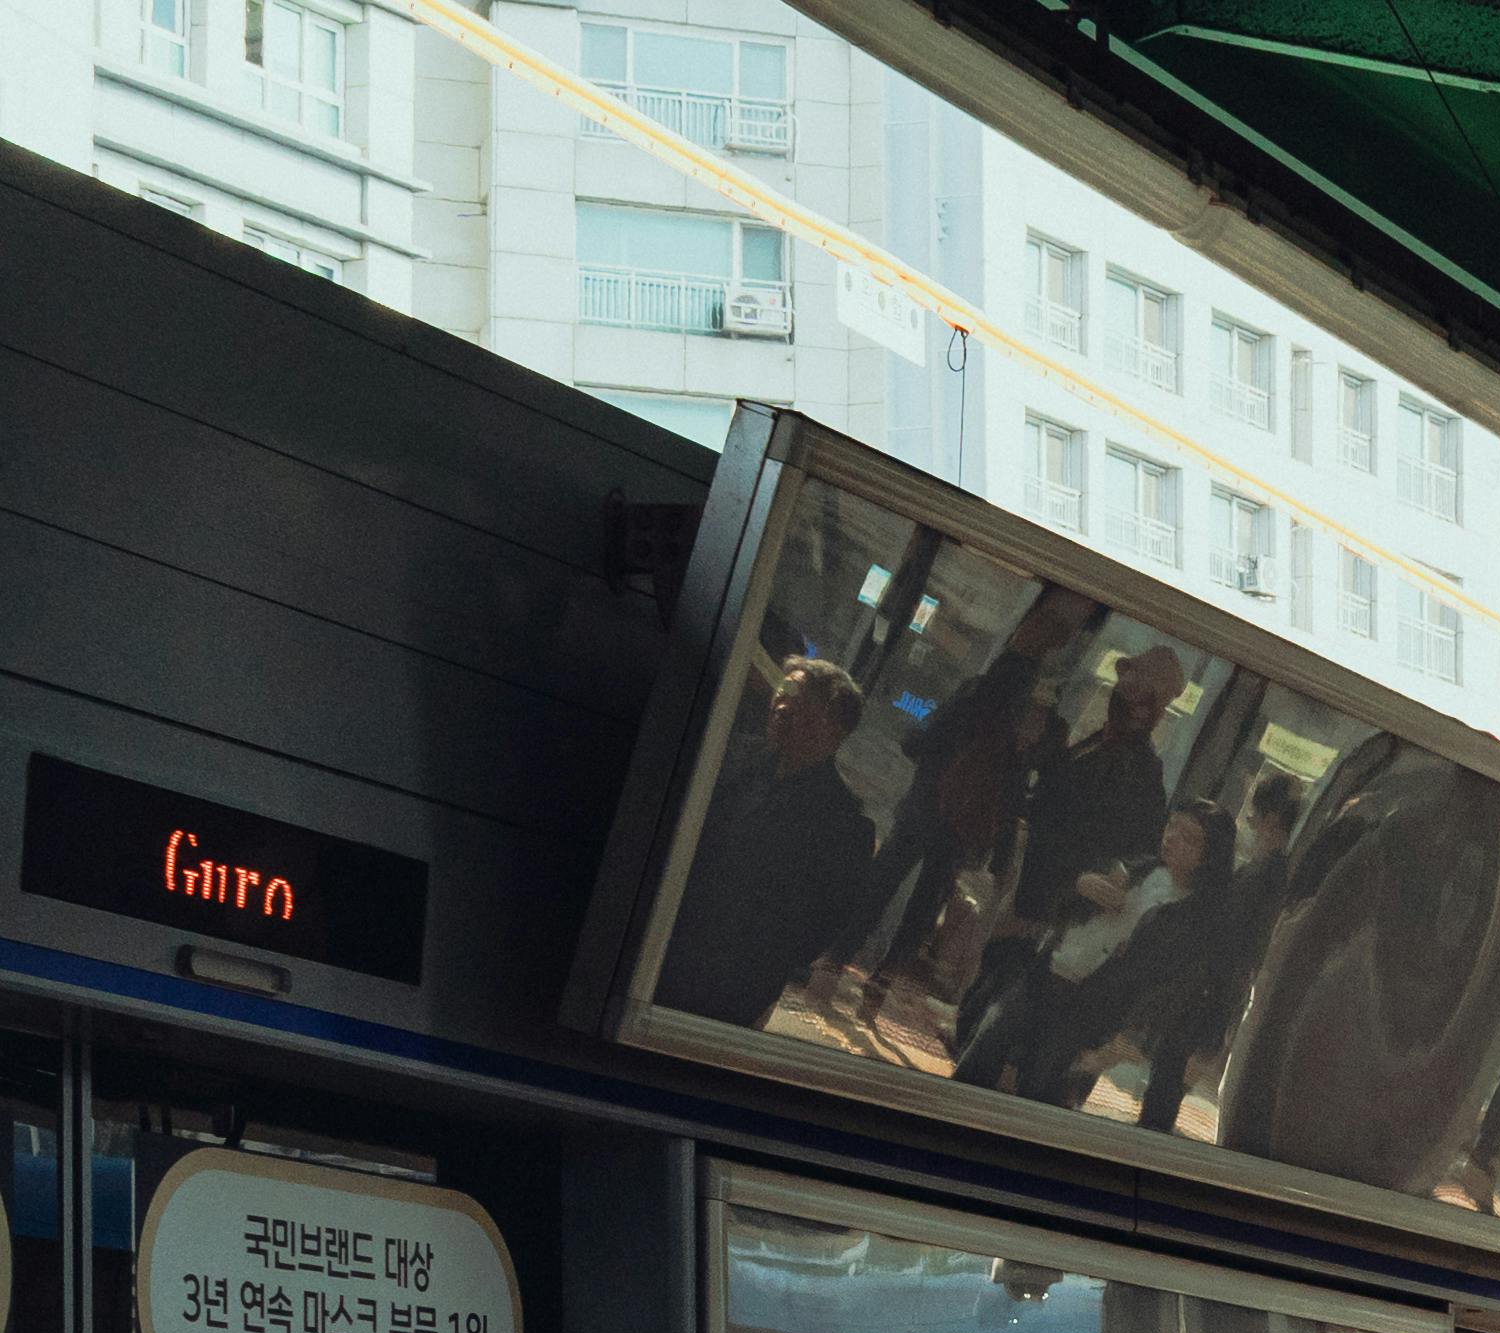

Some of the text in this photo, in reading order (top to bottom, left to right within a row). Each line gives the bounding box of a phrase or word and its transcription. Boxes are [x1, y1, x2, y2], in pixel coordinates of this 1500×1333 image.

[244, 1214, 434, 1292] 국민브랜드 대상
[182, 1273, 229, 1329] 3년
